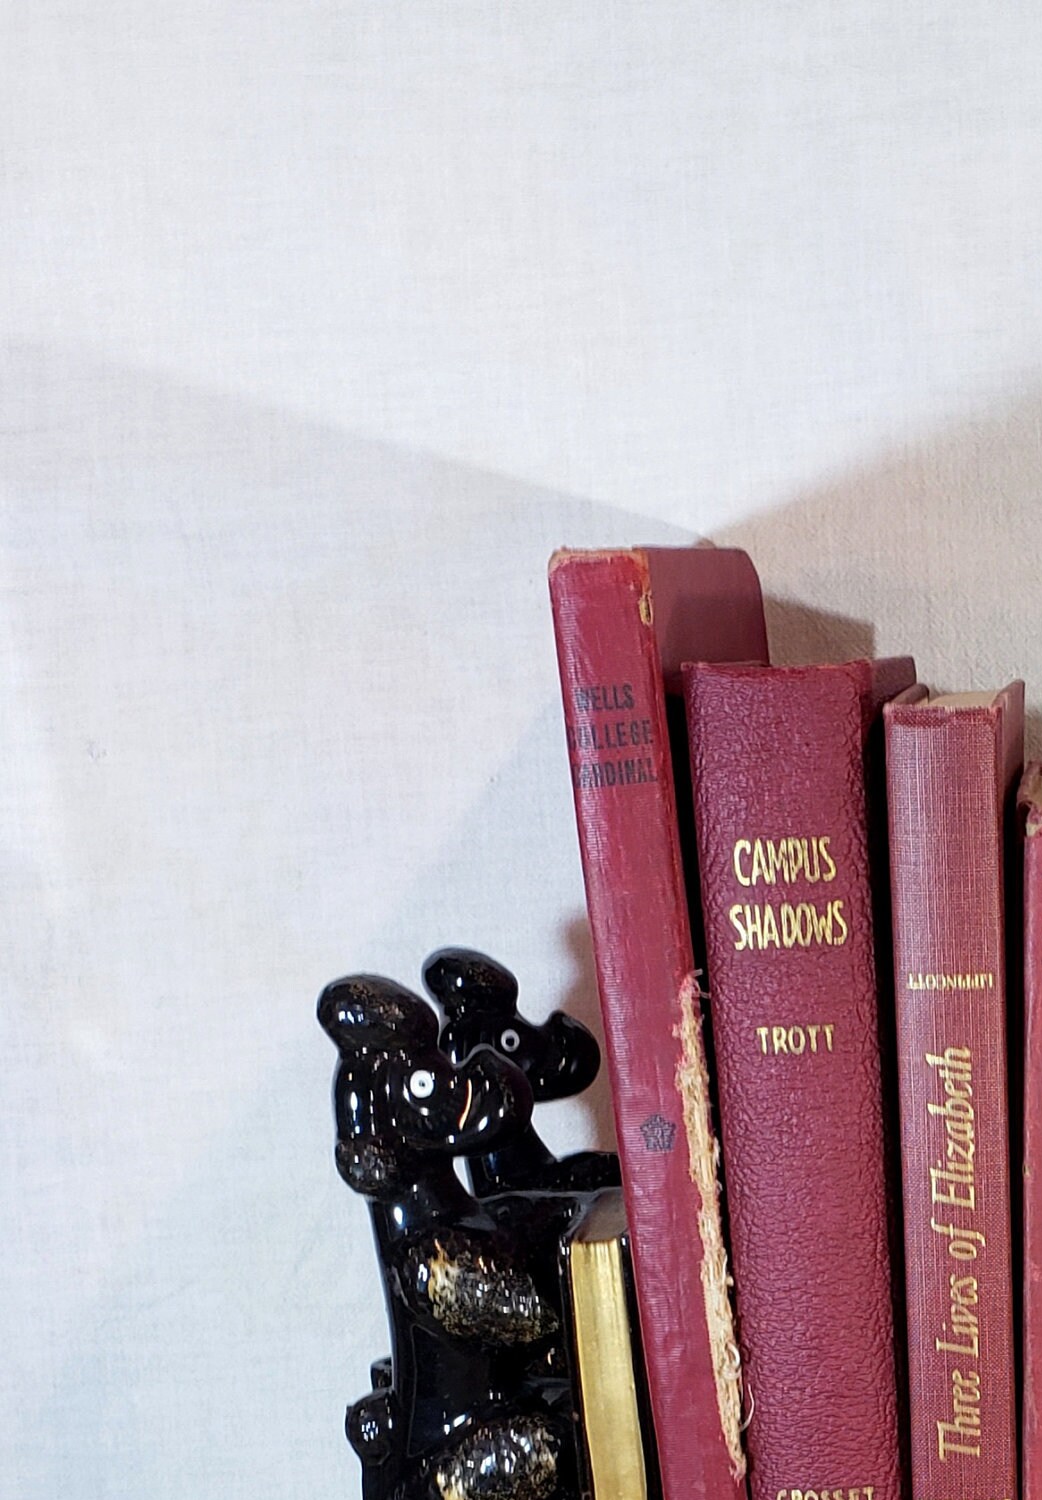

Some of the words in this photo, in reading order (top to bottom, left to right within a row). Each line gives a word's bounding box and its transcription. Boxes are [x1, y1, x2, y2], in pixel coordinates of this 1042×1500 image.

[733, 837, 837, 886] CAMPUS
[729, 900, 848, 951] SHADOWS
[756, 1024, 835, 1055] TROTT
[925, 1046, 976, 1212] Elizabeth
[930, 1217, 986, 1261] of
[936, 1273, 980, 1359] Lives
[936, 1368, 982, 1463] Three
